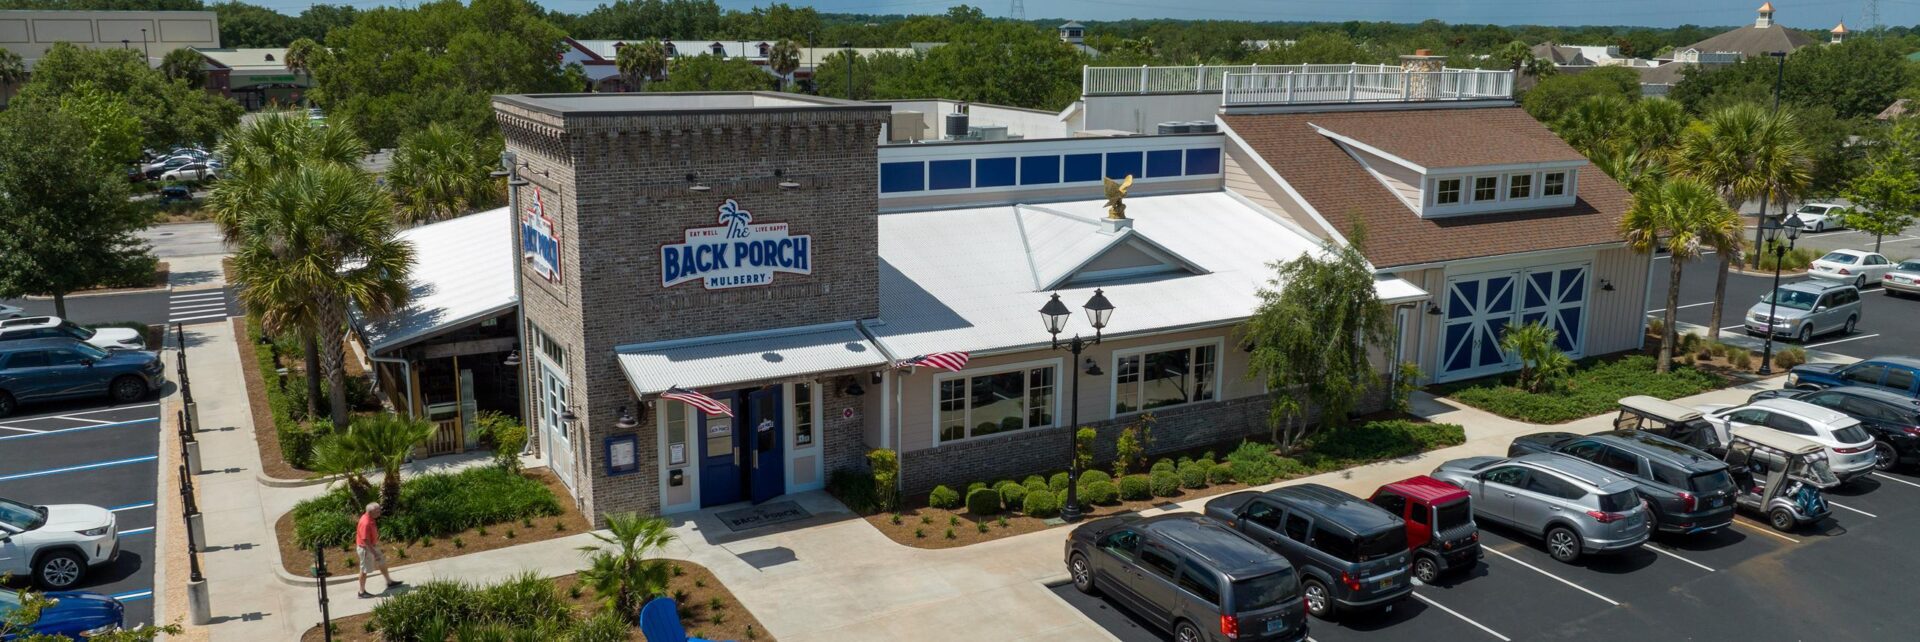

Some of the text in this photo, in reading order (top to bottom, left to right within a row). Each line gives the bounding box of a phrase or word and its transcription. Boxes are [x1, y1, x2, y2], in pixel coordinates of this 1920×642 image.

[726, 209, 751, 239] The
[664, 237, 808, 283] BACK PORCH
[711, 273, 766, 286] MULBERRY
